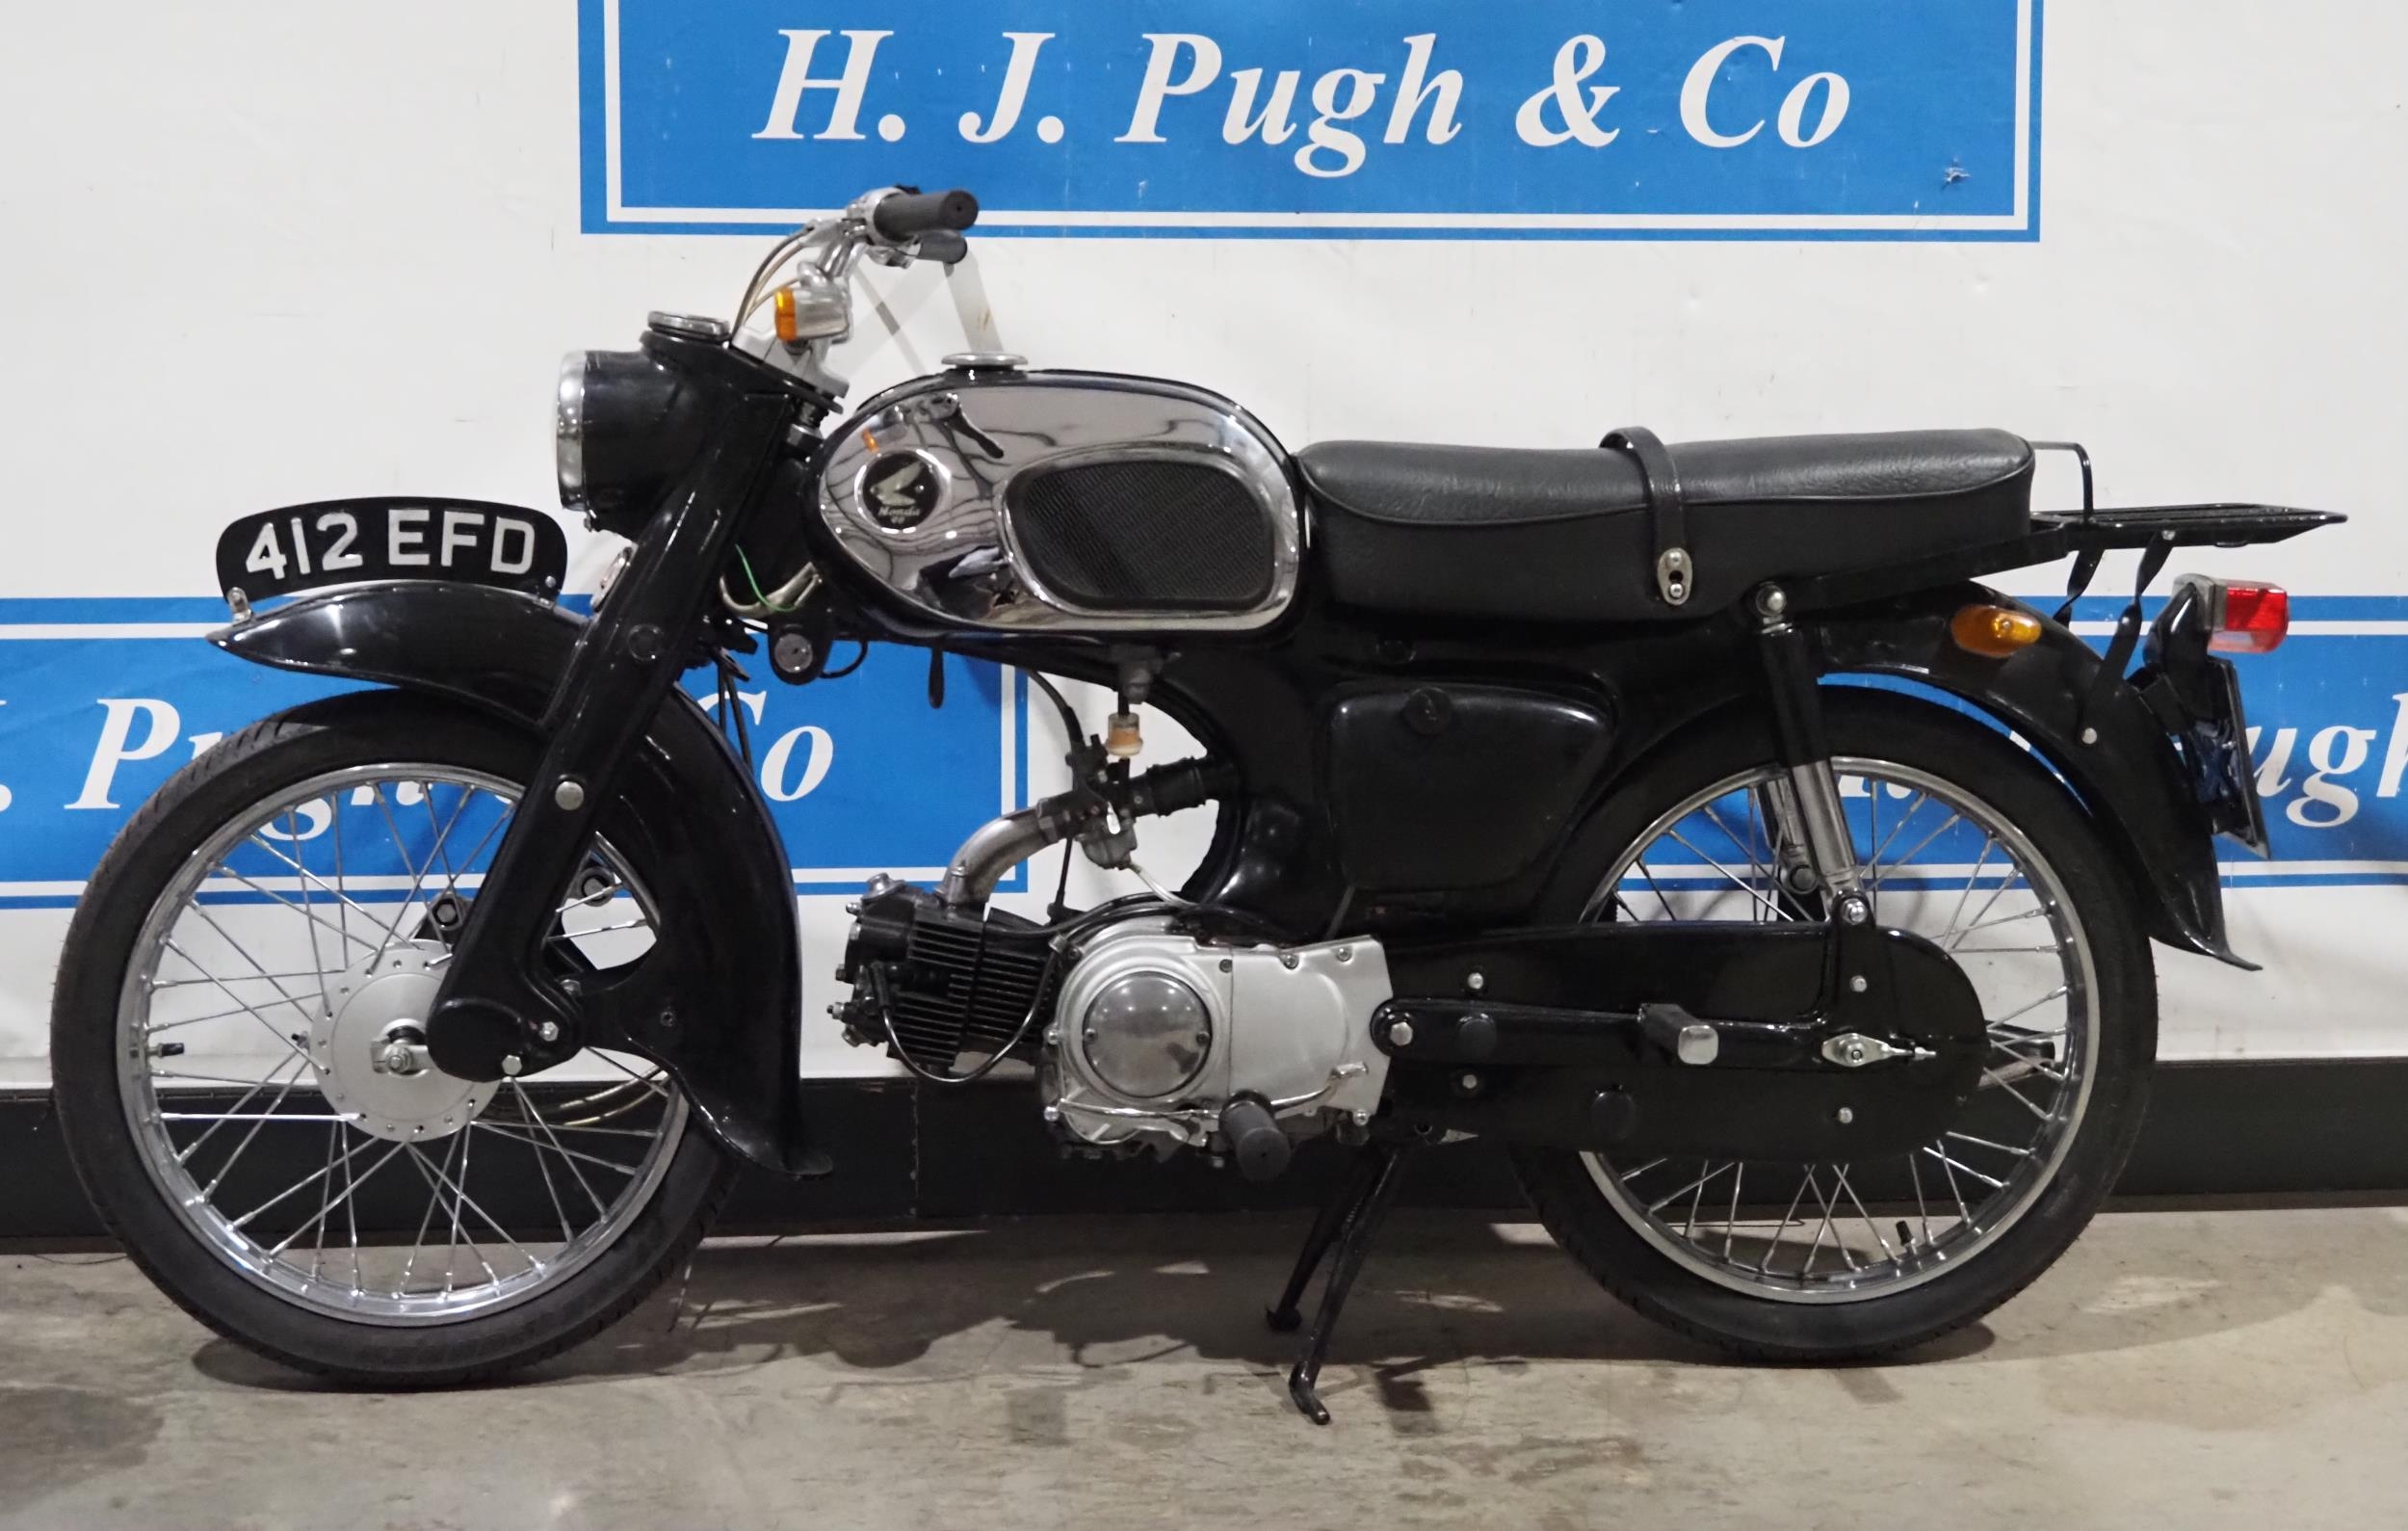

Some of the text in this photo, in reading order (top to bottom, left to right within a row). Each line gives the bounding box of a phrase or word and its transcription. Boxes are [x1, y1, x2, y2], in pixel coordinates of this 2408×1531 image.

[752, 30, 1849, 177] H. J. Pugh & Co
[246, 508, 536, 580] 412 EFD
